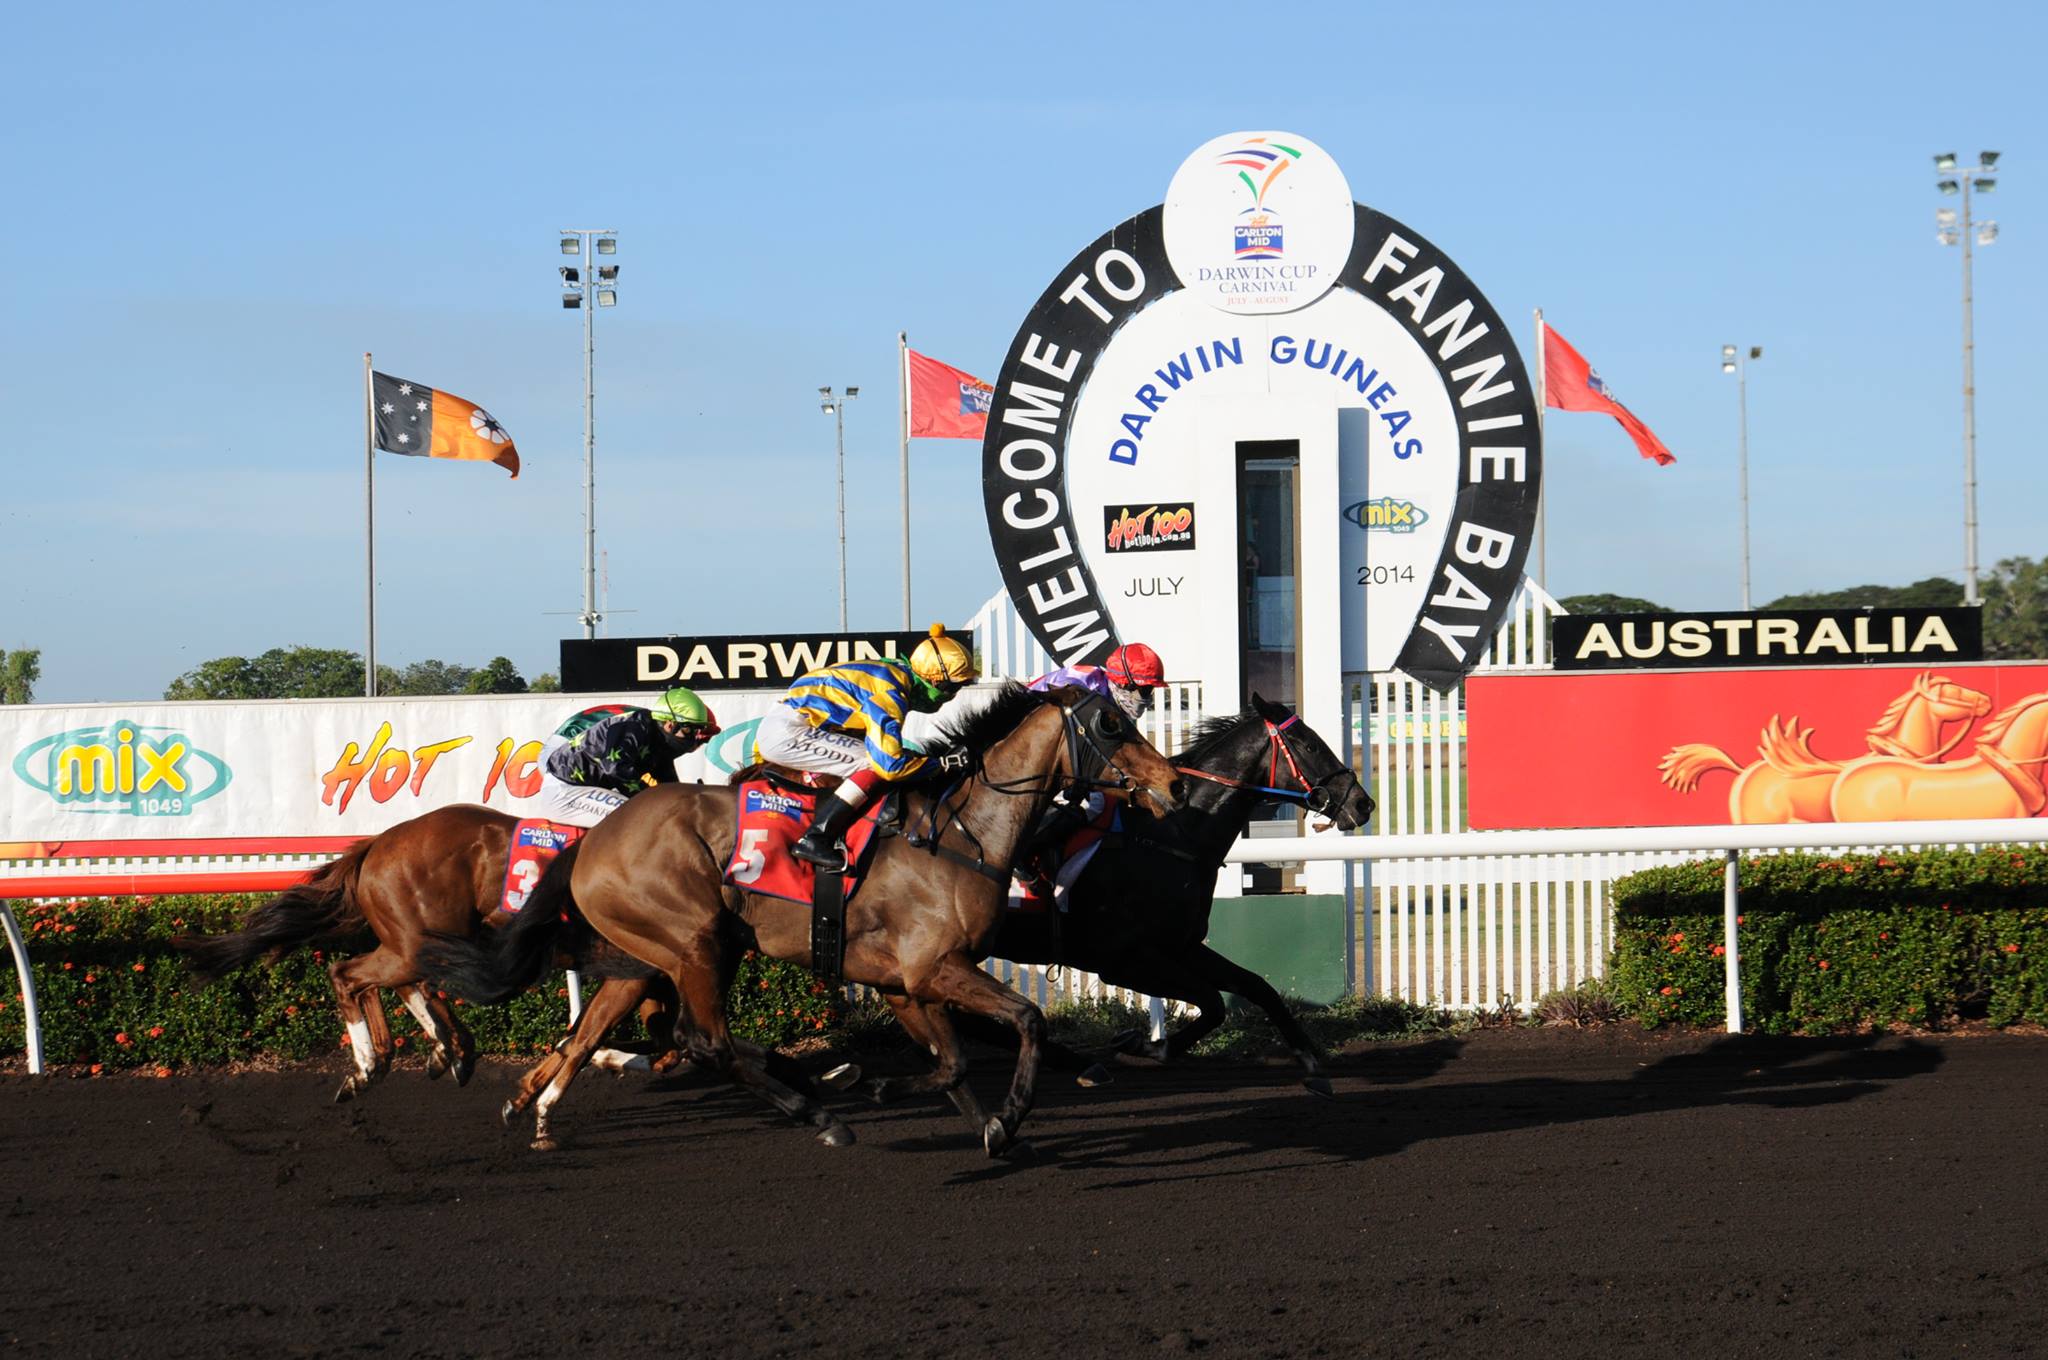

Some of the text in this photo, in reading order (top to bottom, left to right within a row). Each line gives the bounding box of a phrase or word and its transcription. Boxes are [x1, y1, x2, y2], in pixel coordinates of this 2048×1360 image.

[1235, 227, 1282, 238] CARLTON
[1247, 236, 1271, 247] MID
[1199, 264, 1318, 281] DARWIN CUP
[1219, 281, 1297, 294] CARNIVAL
[1227, 296, 1247, 306] JULY
[1255, 295, 1289, 305] AUGUST
[1109, 335, 1423, 466] DARWIN GUINEAS
[1000, 249, 1146, 668] WELCOME TO
[1363, 232, 1526, 664] FANNIE BAY
[1361, 499, 1414, 525] mix
[1108, 505, 1192, 551] HOT 100
[1124, 576, 1184, 597] JULY
[1357, 565, 1415, 585] 2014
[1575, 616, 1958, 659] AUSTRALIA
[637, 640, 896, 681] DARWIN
[57, 728, 187, 795] mix
[321, 721, 473, 815] HOT
[139, 798, 183, 814] 1049
[747, 790, 802, 808] CARLTON
[760, 801, 787, 813] MID
[531, 836, 554, 847] MID
[731, 829, 769, 884] 5
[507, 859, 540, 911] 3
